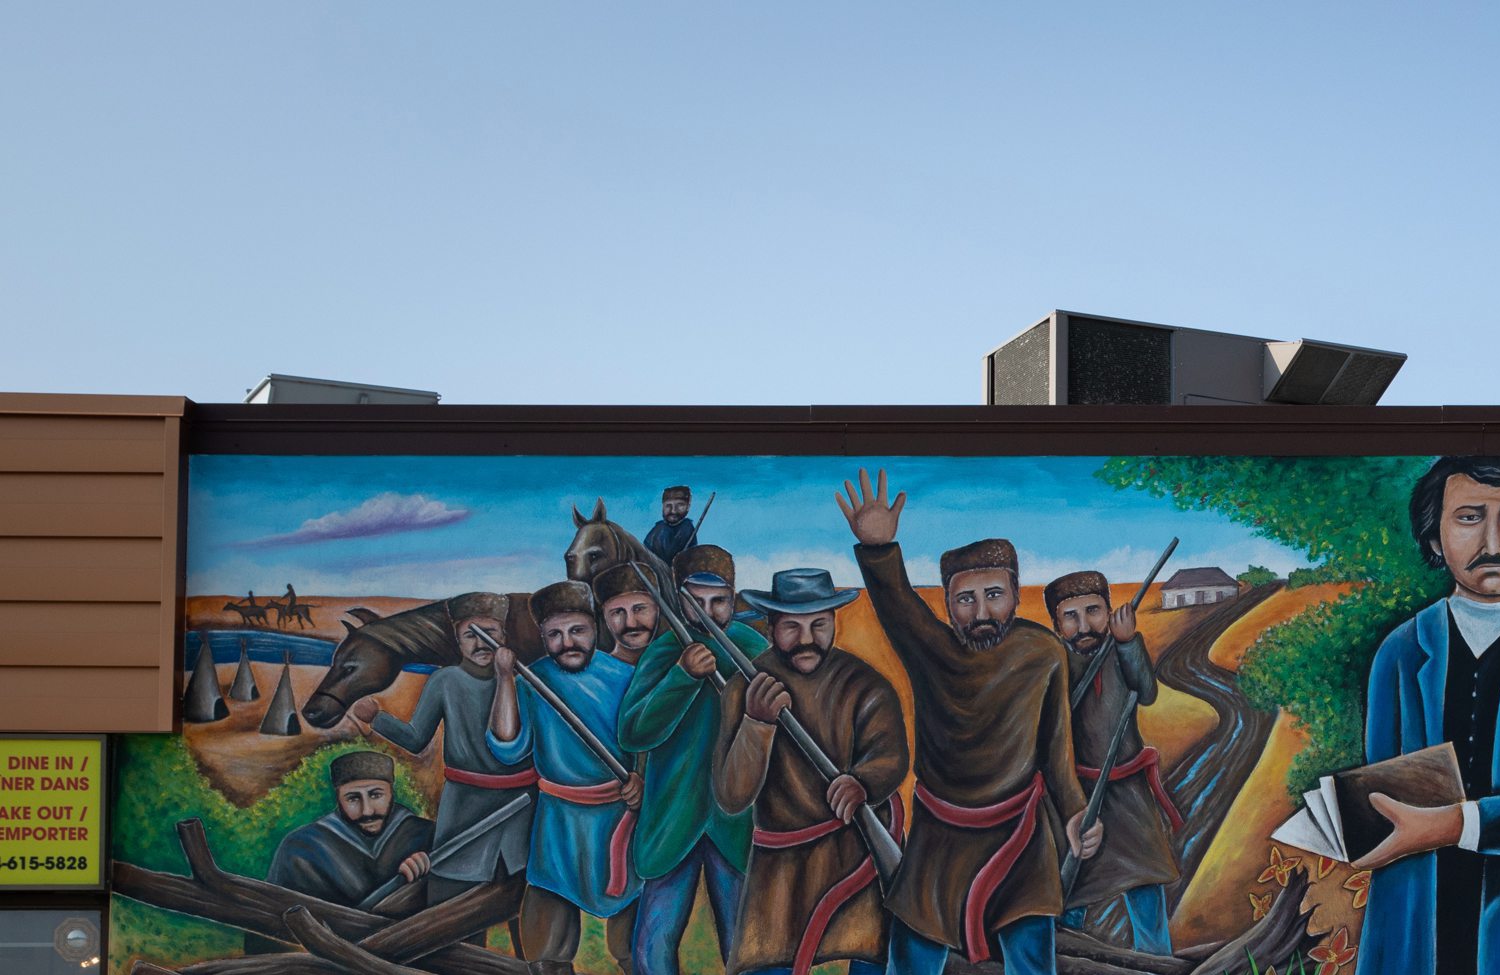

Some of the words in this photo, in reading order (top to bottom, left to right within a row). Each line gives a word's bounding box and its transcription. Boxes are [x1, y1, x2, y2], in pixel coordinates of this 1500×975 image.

[8, 756, 49, 771] DINE
[55, 756, 74, 771] IN
[80, 756, 89, 772] /
[0, 774, 35, 791] NER
[40, 776, 90, 791] DANS
[37, 806, 74, 820] OUT
[79, 806, 88, 822] /
[0, 856, 89, 870] -615-5828
